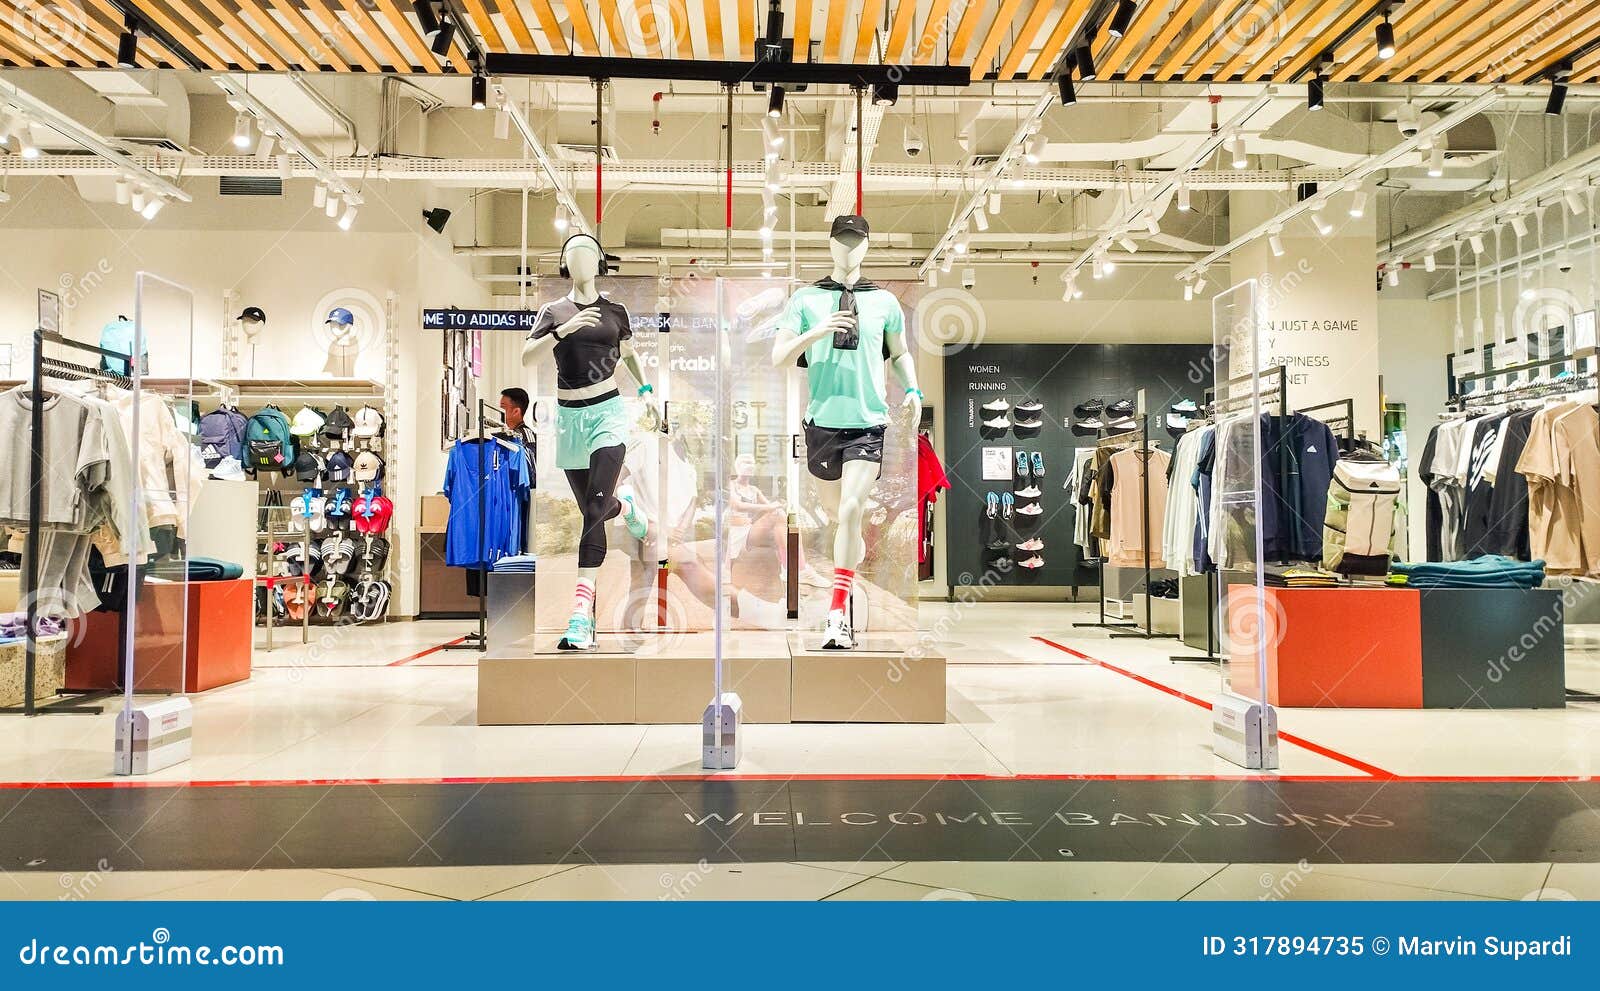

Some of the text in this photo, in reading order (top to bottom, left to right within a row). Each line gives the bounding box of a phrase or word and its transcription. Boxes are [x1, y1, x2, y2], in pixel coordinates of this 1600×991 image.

[424, 313, 444, 325] ME
[449, 314, 466, 325] TO
[470, 314, 516, 326] ADIDAS
[1279, 320, 1308, 331] JUST
[1311, 320, 1320, 331] A
[1323, 320, 1359, 331] GAME
[1268, 356, 1330, 367] APPINESS
[968, 365, 1000, 374] WOMEN
[968, 382, 1007, 391] RUNNING
[684, 812, 1394, 826] WELCOME BANDUNG
